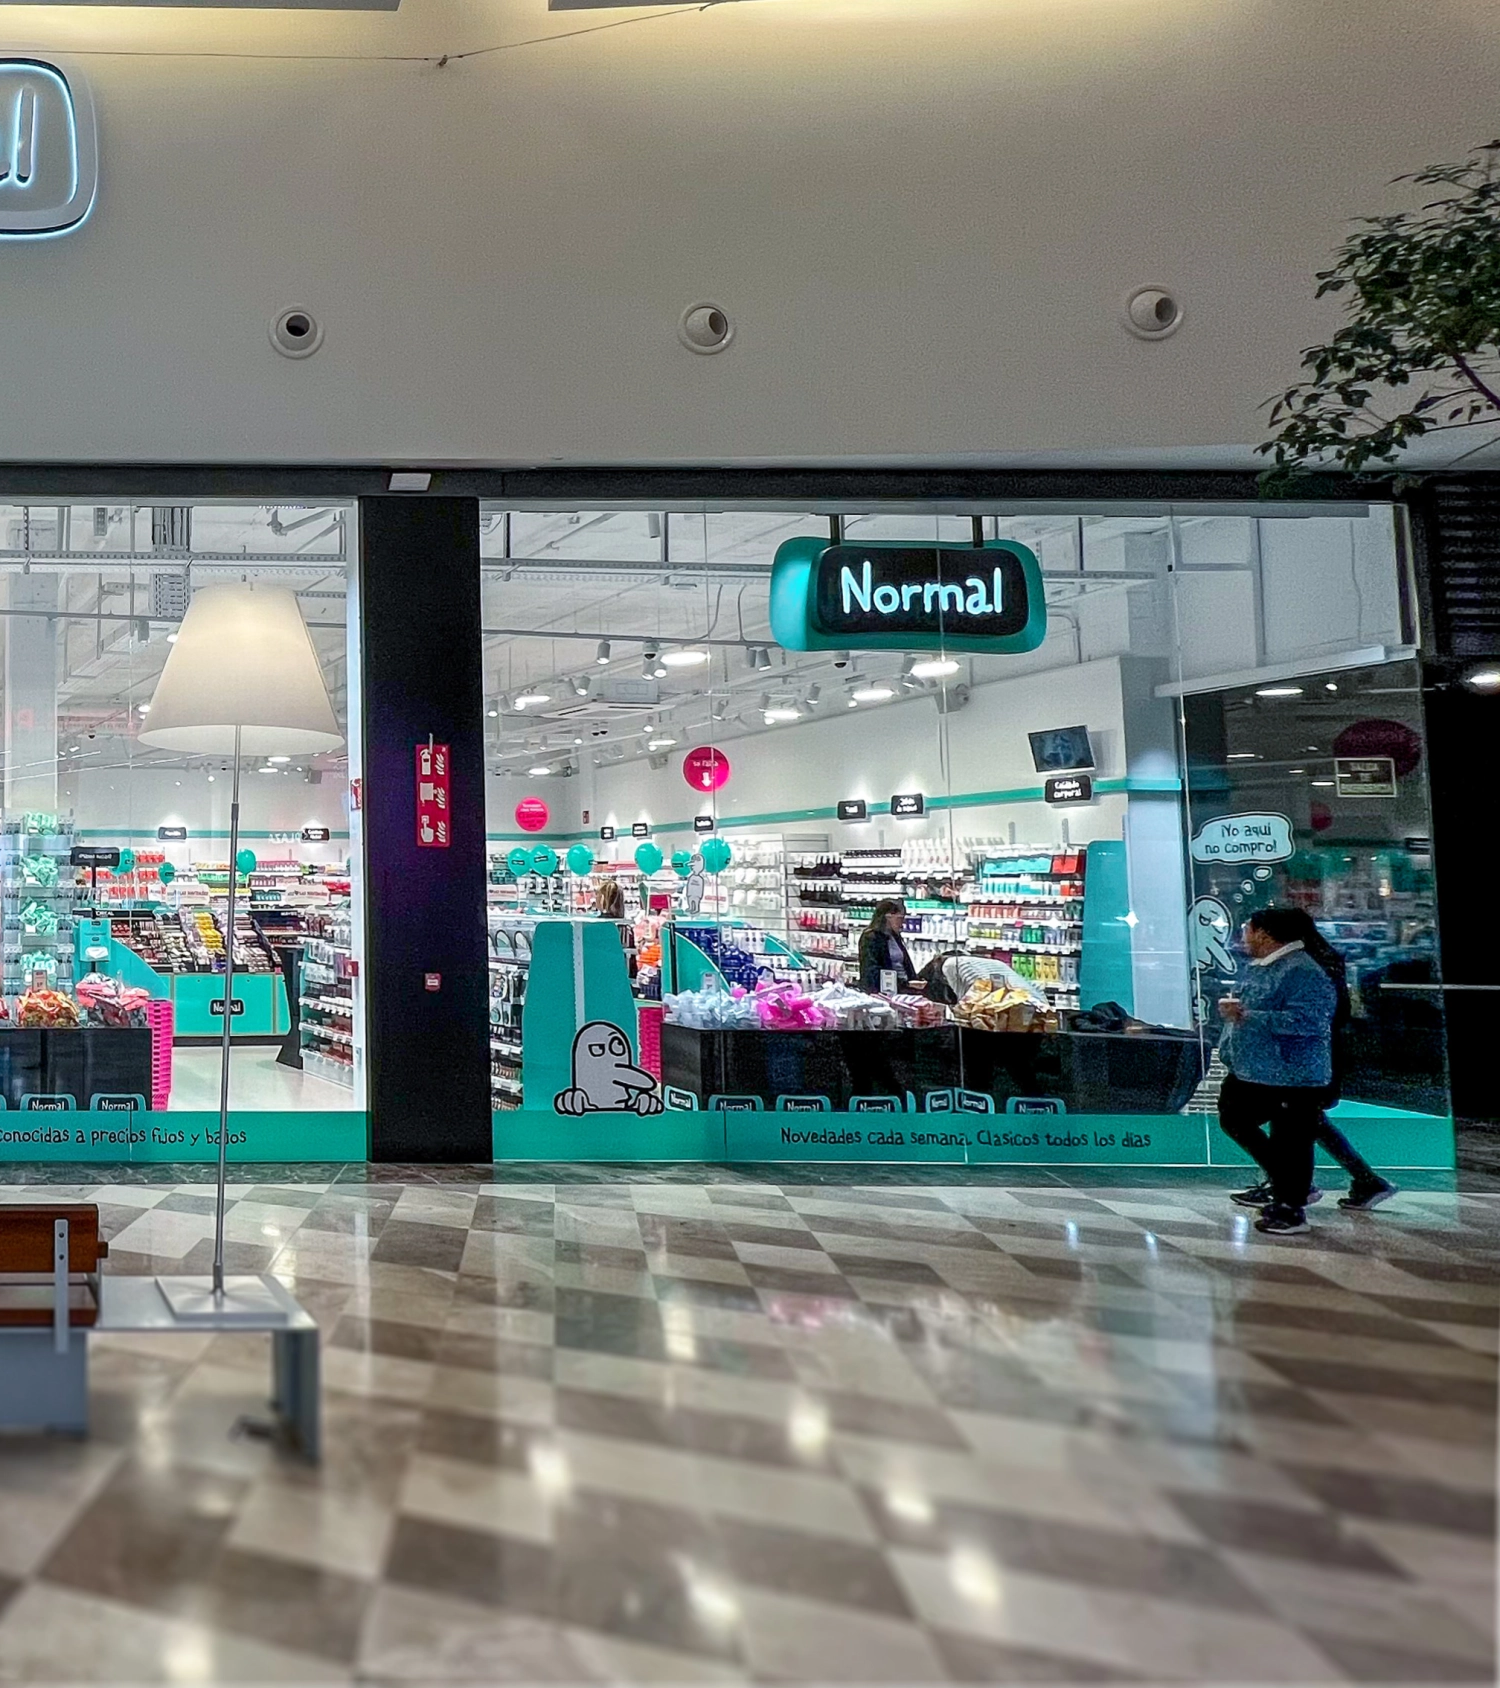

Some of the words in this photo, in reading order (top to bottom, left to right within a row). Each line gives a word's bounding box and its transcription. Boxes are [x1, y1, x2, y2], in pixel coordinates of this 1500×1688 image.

[840, 560, 1003, 615] Normal
[1205, 844, 1220, 854] no
[1224, 839, 1278, 856] compro!
[213, 1001, 241, 1013] Noal
[32, 1100, 65, 1111] Normal
[101, 1099, 135, 1111] Normal
[786, 1101, 820, 1112] Normal
[858, 1102, 892, 1113] Normal
[75, 1129, 86, 1143] a
[91, 1127, 147, 1147] precios
[151, 1127, 185, 1145] fijos
[190, 1132, 200, 1147] y
[780, 1127, 862, 1146] Novedades
[867, 1128, 905, 1146] cada
[1045, 1130, 1089, 1147] todos
[1094, 1130, 1116, 1147] los
